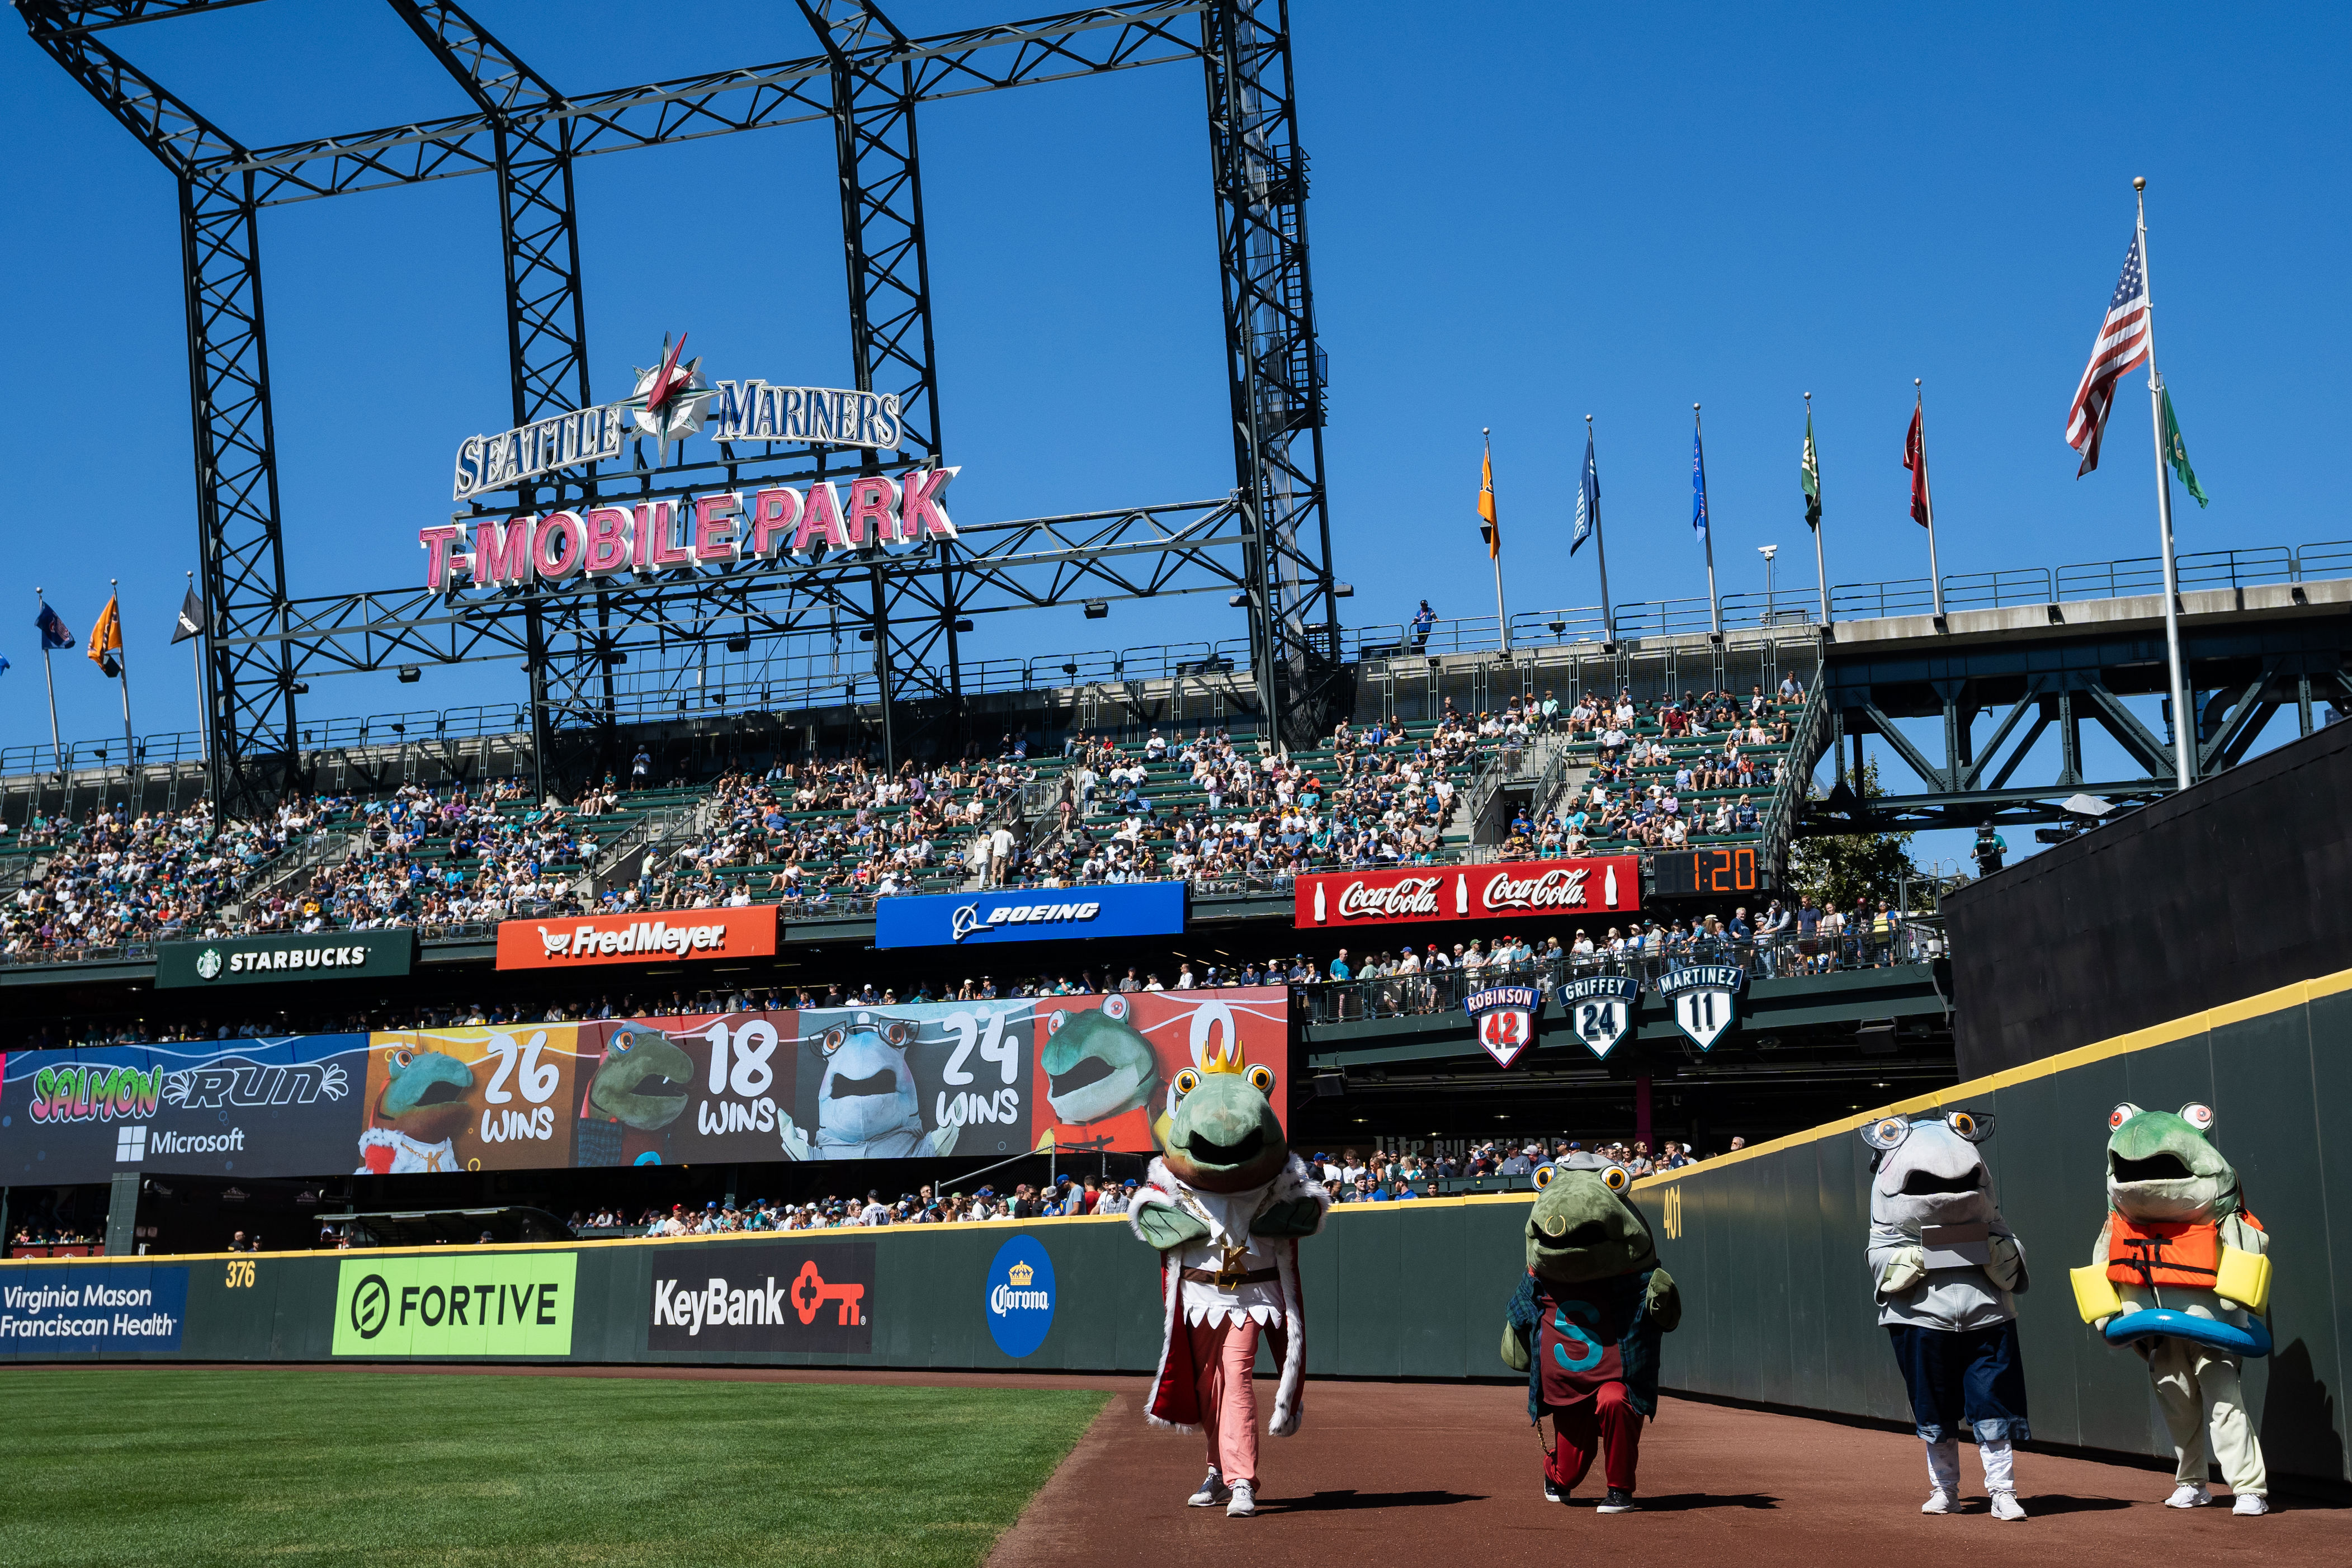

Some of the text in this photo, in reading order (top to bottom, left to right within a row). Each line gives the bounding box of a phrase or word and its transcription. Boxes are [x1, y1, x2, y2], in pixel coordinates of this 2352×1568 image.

[712, 379, 903, 450] MARINERS
[454, 406, 624, 500] SEATTLE
[419, 466, 961, 593] T-MOBILE PARK
[1482, 867, 1590, 910] Coca-Cola
[1694, 849, 1756, 891] 1:20
[986, 902, 1101, 924] BOEING
[1339, 876, 1443, 917] Coca-Cola
[230, 946, 365, 971] STARBUCKS
[1467, 988, 1532, 1012] ROBINSON
[1565, 977, 1626, 1000] GRIFFEY
[1660, 966, 1736, 994] MARTINEZ
[1485, 1012, 1519, 1046] 42
[1583, 1002, 1617, 1036] 24
[1689, 993, 1716, 1028] 11
[942, 1011, 1019, 1085] 24
[1189, 1000, 1236, 1069] 0
[485, 1030, 560, 1104] 26
[704, 1019, 779, 1098] 18
[30, 1064, 325, 1124] SALMON RUN
[936, 1088, 1018, 1128] WINS
[480, 1106, 555, 1144] WINS
[698, 1097, 778, 1136] WINS
[151, 1127, 245, 1154] Microsoft
[1664, 1184, 1682, 1239] 401
[225, 1260, 256, 1288] 376
[4, 1284, 152, 1314] Virginia Mason
[399, 1283, 559, 1326] FORTIVE
[654, 1277, 785, 1336] KeyBank
[991, 1283, 1049, 1317] Corona
[0, 1312, 172, 1337] Franciscan Health
[1554, 1300, 1604, 1372] S
